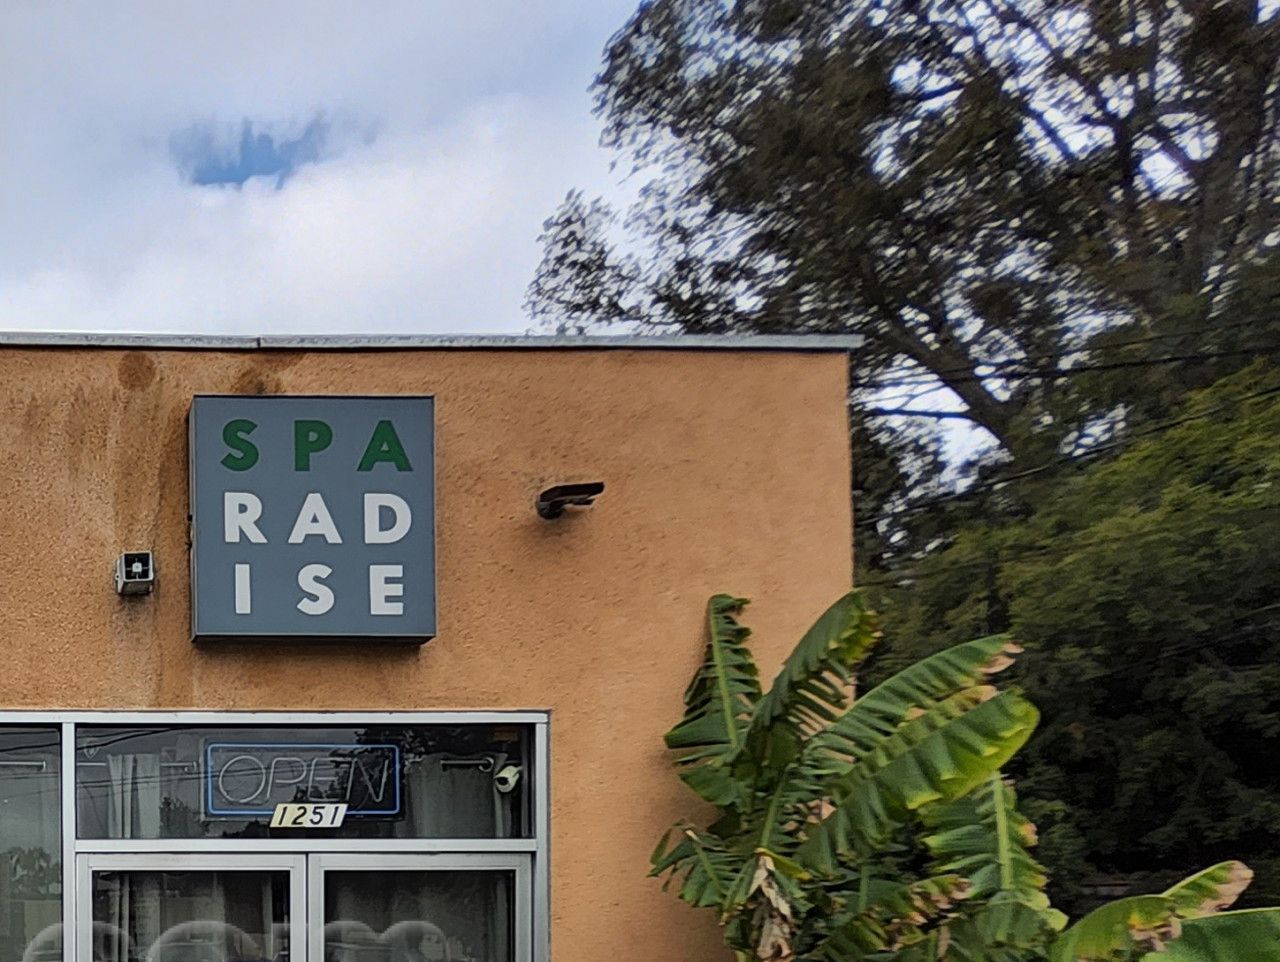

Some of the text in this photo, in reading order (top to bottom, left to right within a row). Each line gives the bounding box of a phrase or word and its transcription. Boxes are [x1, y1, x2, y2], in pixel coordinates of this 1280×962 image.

[220, 418, 413, 472] SPA
[224, 491, 412, 544] RAD
[235, 563, 404, 615] ISE
[220, 755, 389, 803] OPEN
[278, 806, 340, 826] 1251
